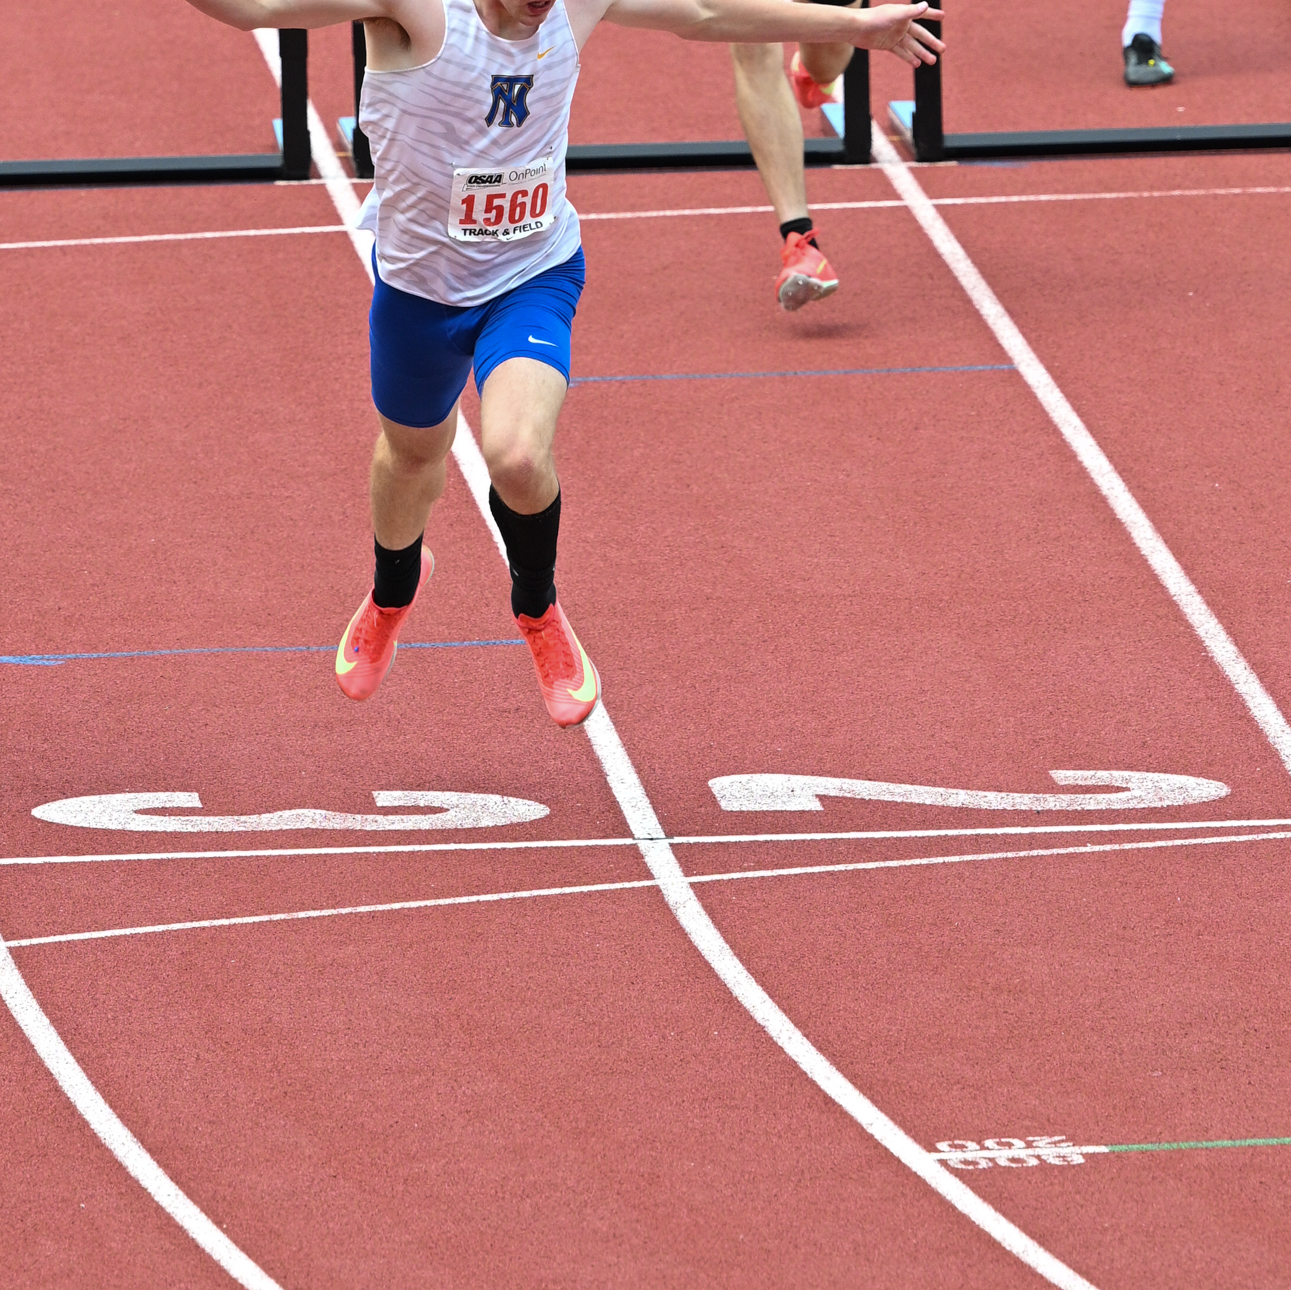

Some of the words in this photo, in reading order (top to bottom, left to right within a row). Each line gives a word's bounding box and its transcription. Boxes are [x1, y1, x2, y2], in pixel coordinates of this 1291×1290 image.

[467, 174, 503, 185] OSAA
[508, 163, 547, 182] OnPoint
[458, 182, 549, 227] 1560
[461, 228, 499, 237] TRACK
[502, 228, 510, 236] &
[512, 220, 543, 234] FIELD
[30, 790, 551, 831] 3
[707, 769, 1232, 812] 2
